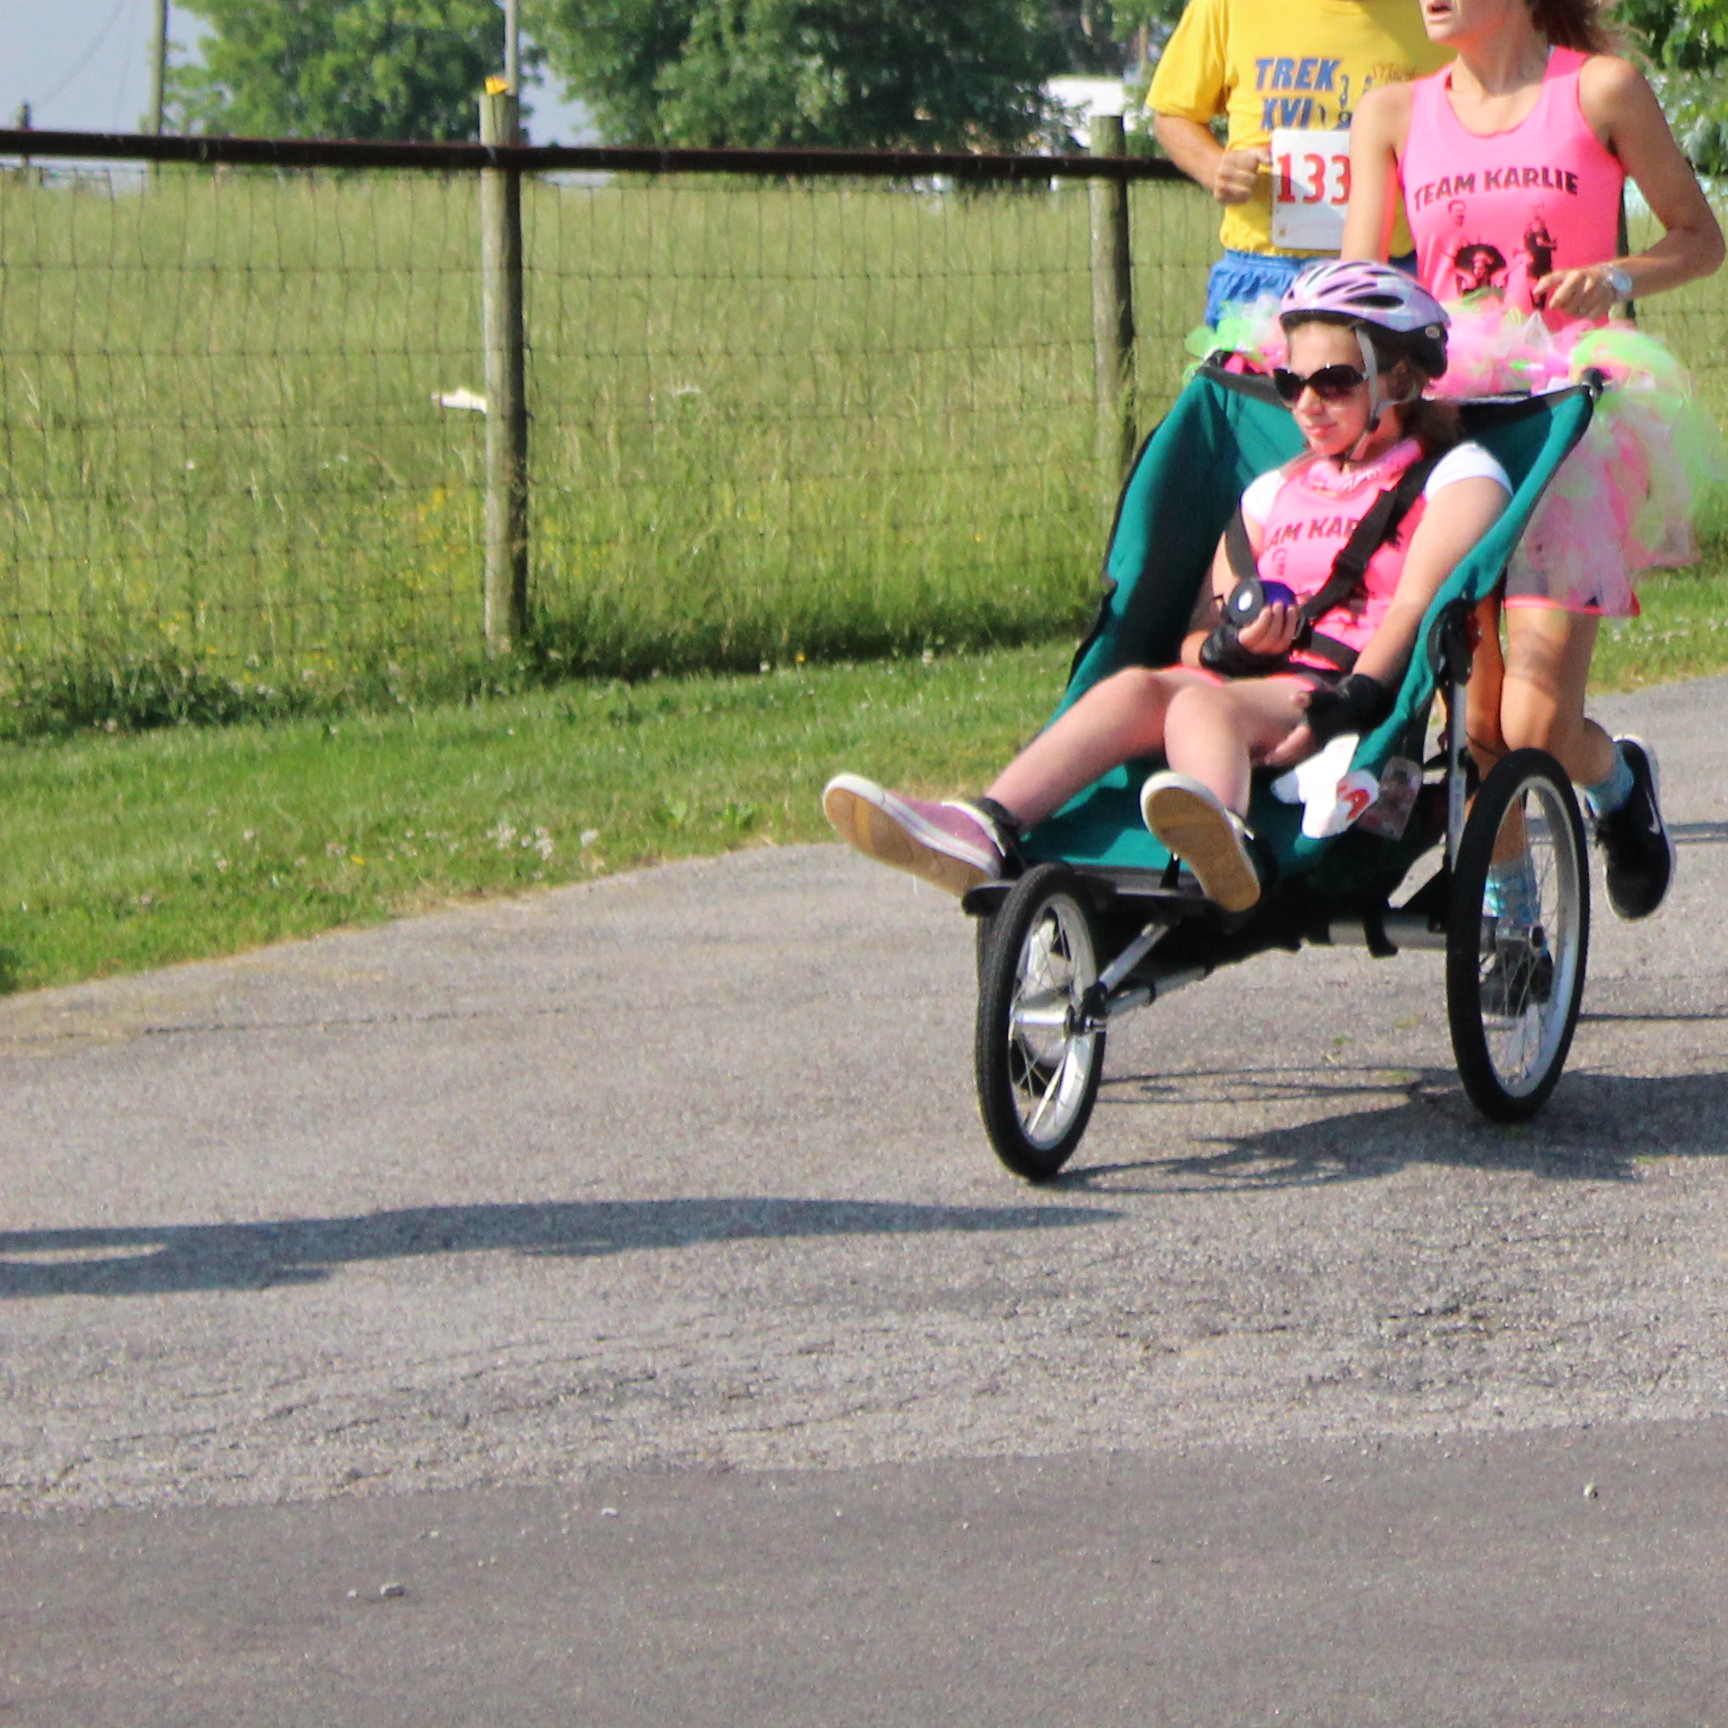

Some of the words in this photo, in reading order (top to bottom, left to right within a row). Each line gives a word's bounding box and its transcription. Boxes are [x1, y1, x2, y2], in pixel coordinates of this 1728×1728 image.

[1255, 57, 1341, 92] TREK
[1261, 97, 1314, 131] XVI
[1413, 173, 1476, 213] TEAM
[1484, 166, 1579, 196] KARLIE
